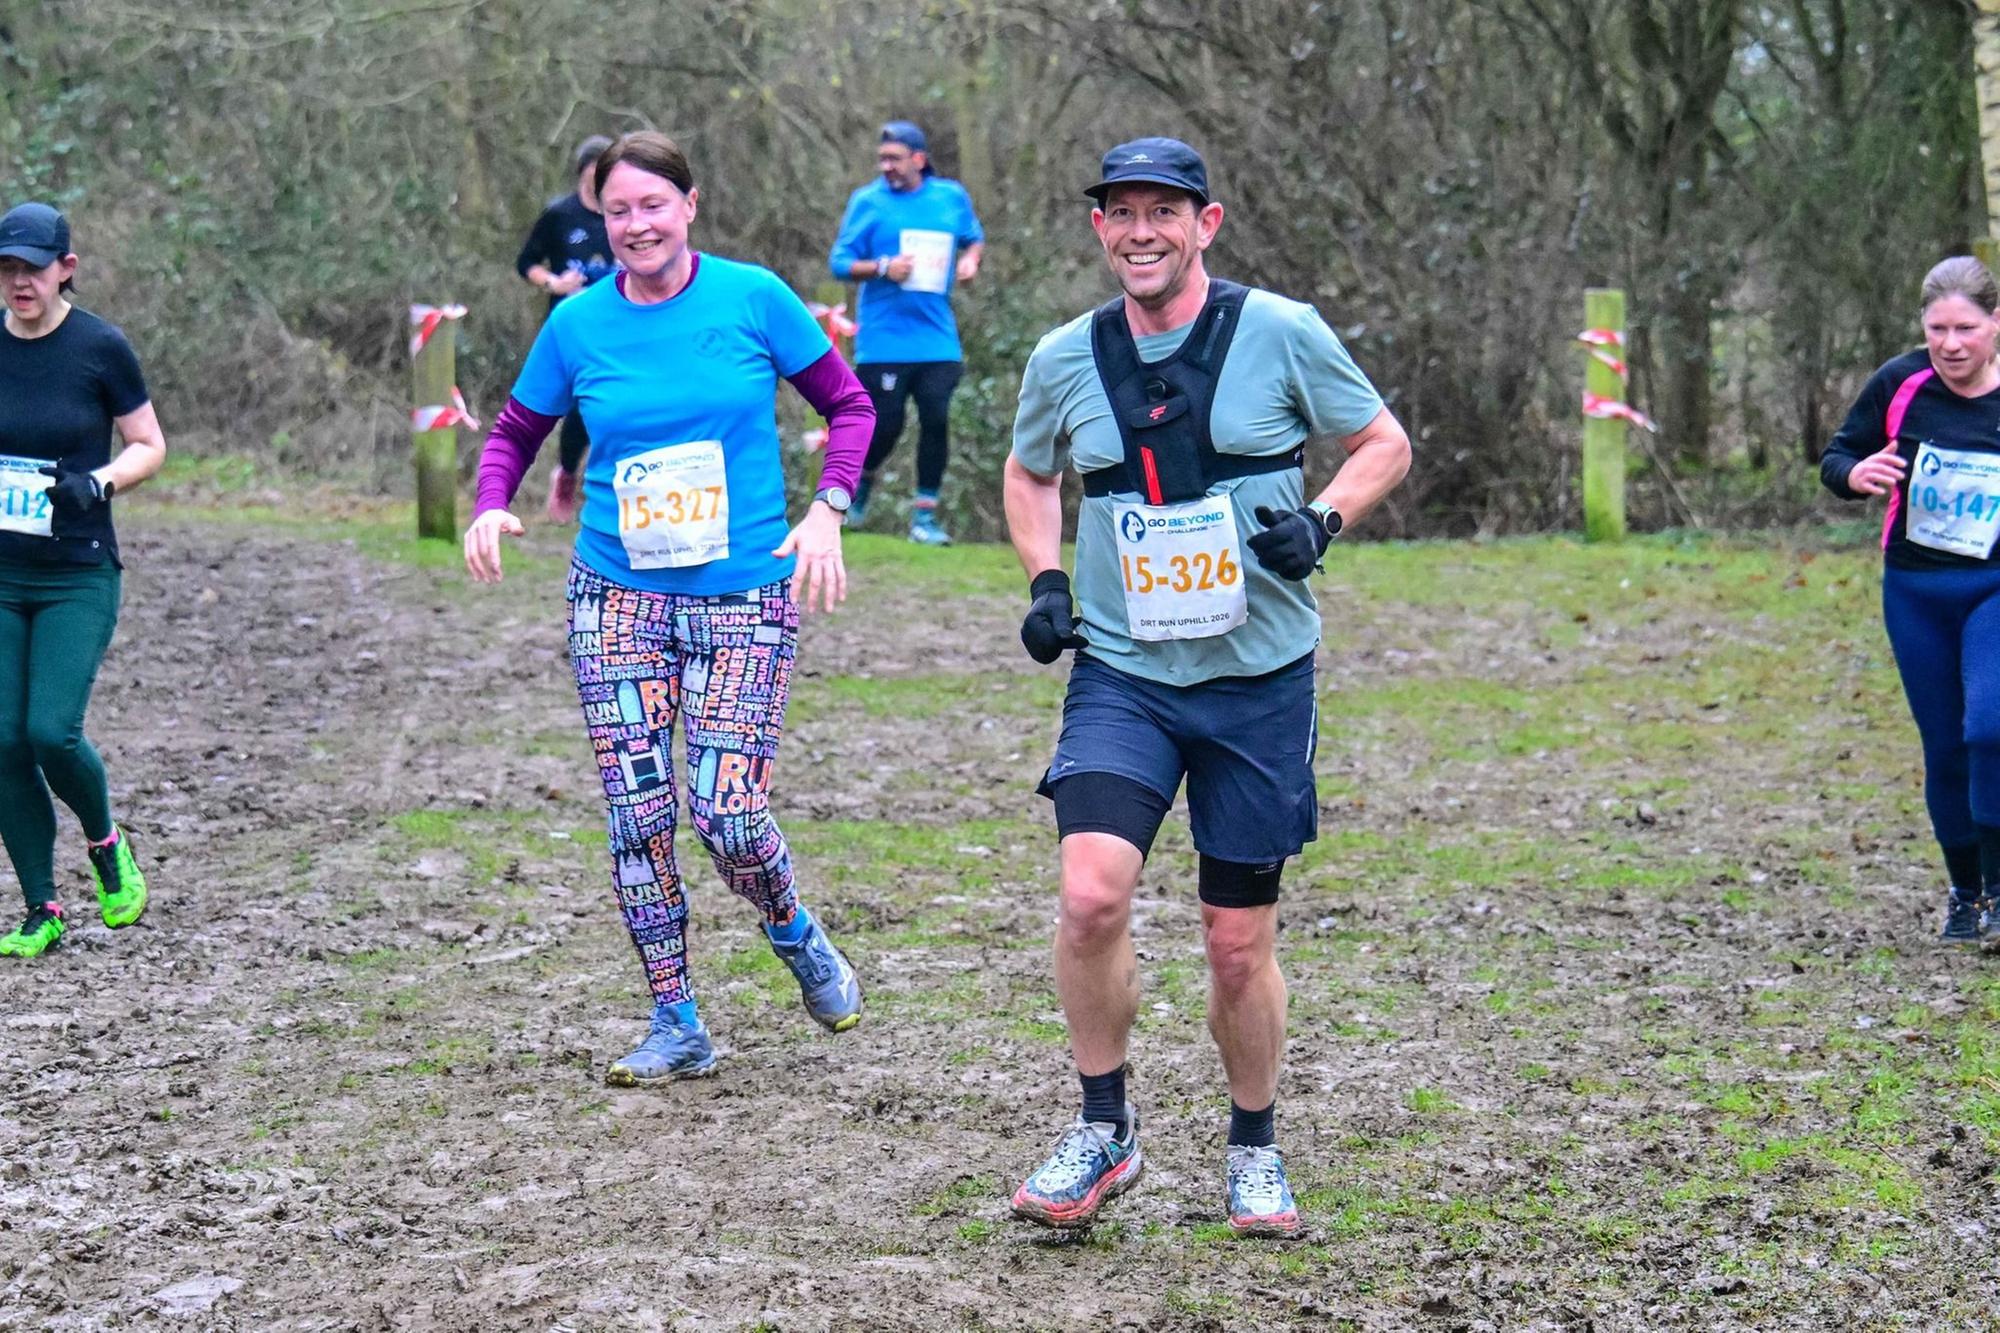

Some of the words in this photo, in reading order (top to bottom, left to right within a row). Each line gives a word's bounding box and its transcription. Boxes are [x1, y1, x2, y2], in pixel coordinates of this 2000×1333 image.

[0, 487, 49, 519] 112
[622, 486, 722, 531] 15-327
[1911, 483, 2000, 522] 10-147
[1148, 518, 1167, 528] GO
[1168, 511, 1225, 527] BEYOND
[1167, 525, 1208, 535] CHALLENGE
[1122, 548, 1238, 594] 15-326
[707, 605, 761, 614] RUNNER
[762, 609, 783, 621] RU
[602, 588, 623, 655] TIKIBOO
[618, 590, 638, 653] RUNNER
[711, 615, 748, 626] RUN
[1140, 618, 1157, 627] DIRT
[1158, 618, 1176, 627] RUN
[1177, 616, 1209, 626] UPHILL
[1211, 612, 1230, 623] 2026
[701, 615, 711, 654] LONDON
[712, 634, 751, 646] RUN
[578, 657, 602, 676] UN
[601, 651, 662, 666] TIKIBOO
[603, 669, 655, 681] RUNNER
[745, 658, 758, 682] RUN
[757, 656, 770, 684] RUN
[704, 647, 730, 719] TIKIBOO
[717, 648, 747, 719] RUNNER
[737, 701, 768, 712] TIKIBO
[646, 709, 674, 731] LO
[700, 718, 757, 734] TIKIBOO
[609, 723, 650, 742] RUN
[697, 737, 743, 750] RUNNER
[634, 796, 665, 819] RUN
[637, 806, 671, 828] LONDON
[626, 902, 669, 922] UN
[642, 934, 684, 960] RUN
[648, 957, 674, 972] RUN
[652, 977, 682, 993] NER
